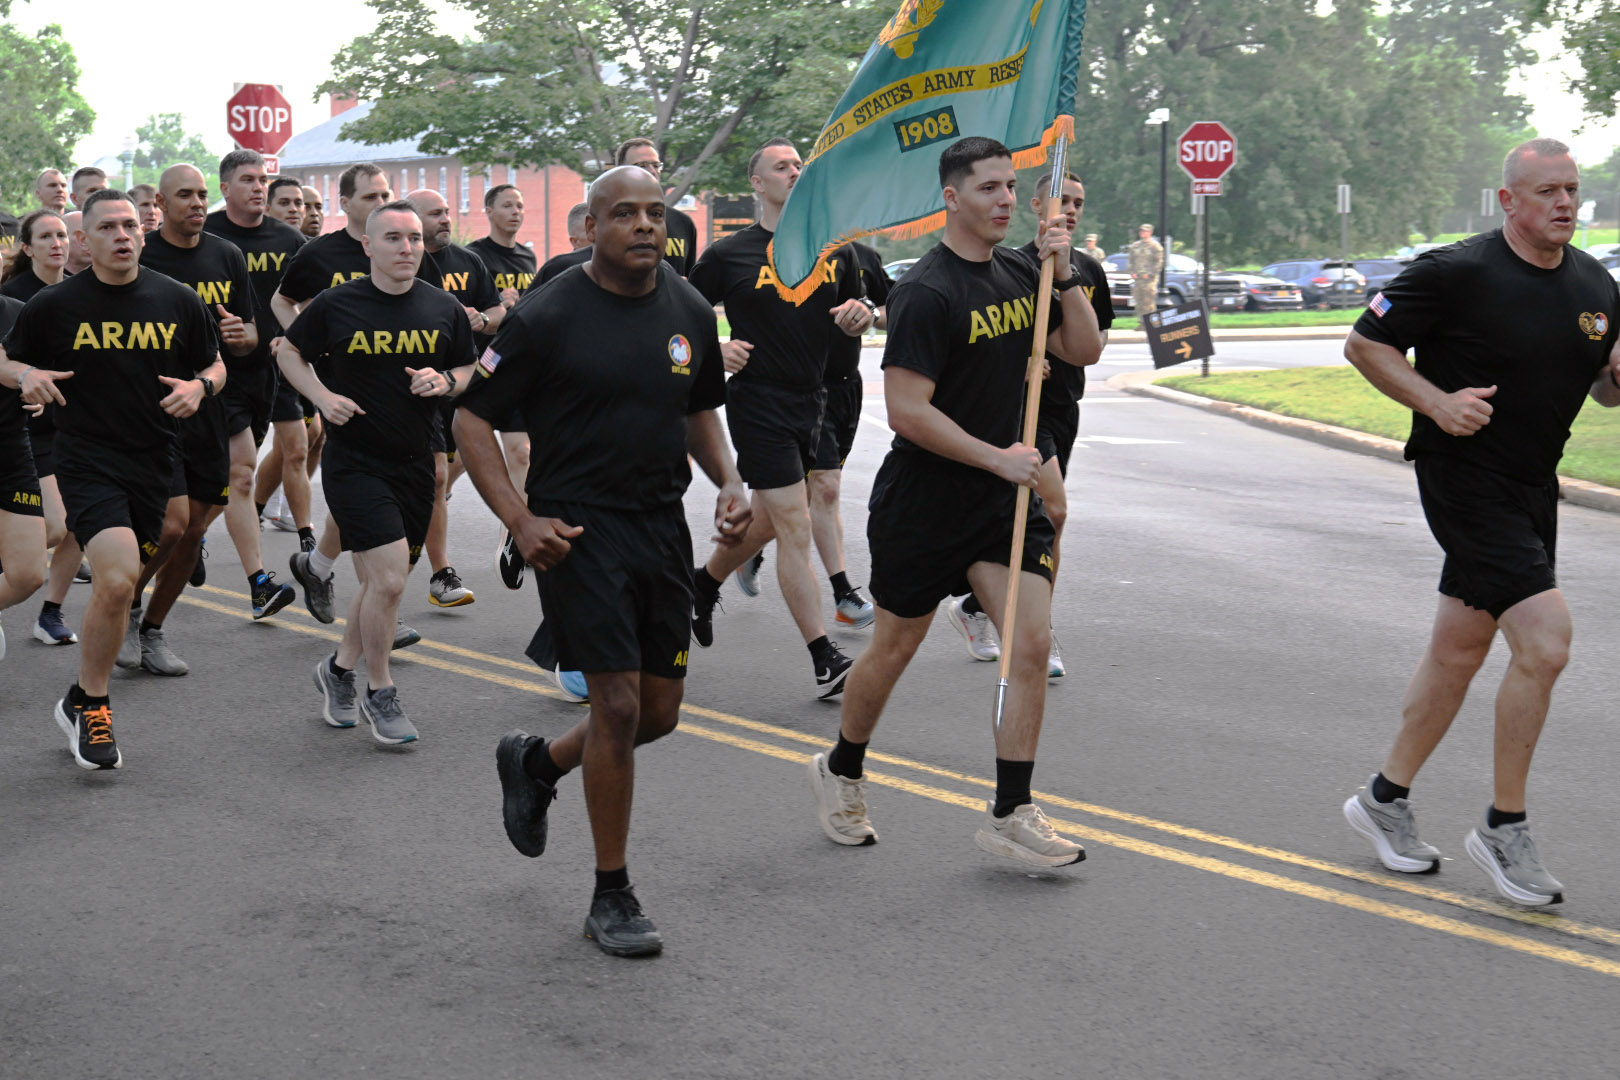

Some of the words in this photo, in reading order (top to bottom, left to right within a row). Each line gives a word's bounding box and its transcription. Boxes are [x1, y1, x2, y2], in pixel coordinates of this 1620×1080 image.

[853, 83, 914, 126] STATES
[922, 69, 976, 94] ARMY
[230, 105, 289, 133] STOP
[899, 113, 954, 147] 1908
[1181, 140, 1233, 162] STOP
[72, 321, 178, 350] ARMY
[347, 329, 440, 355] ARMY
